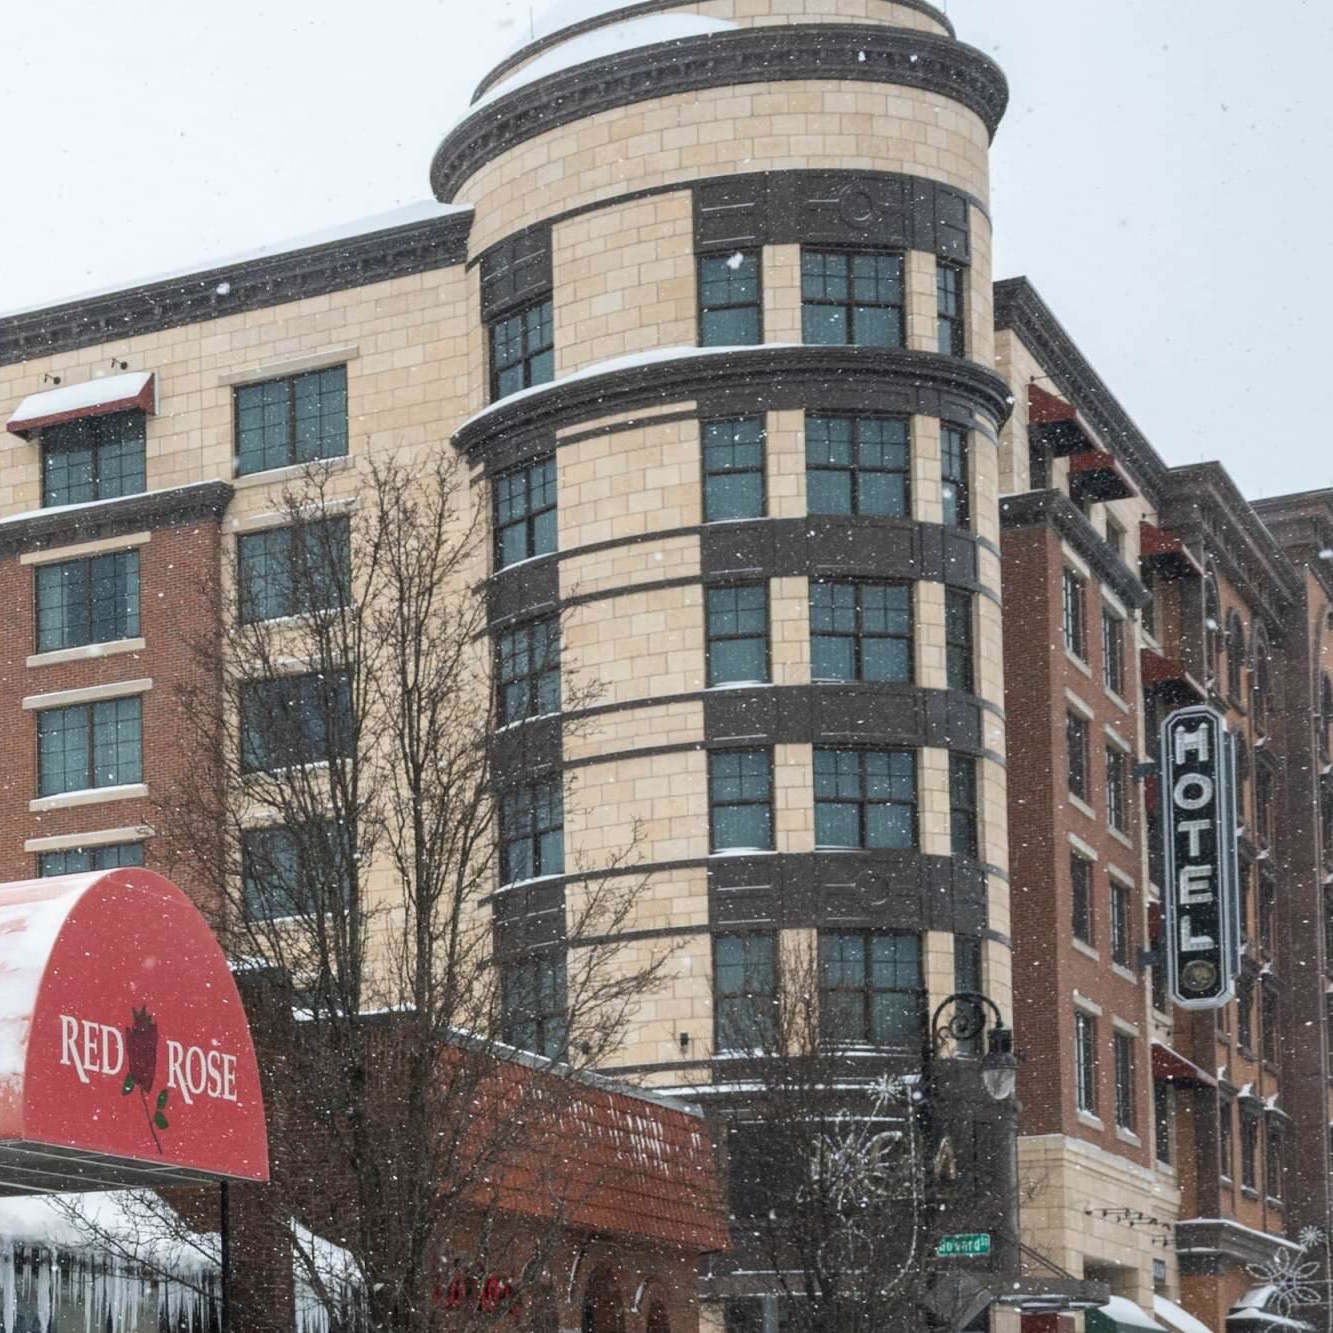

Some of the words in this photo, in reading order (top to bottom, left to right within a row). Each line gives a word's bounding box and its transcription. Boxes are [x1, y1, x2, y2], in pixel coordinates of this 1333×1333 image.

[1173, 722, 1216, 952] HOTEL
[59, 1014, 125, 1084] RED
[165, 1039, 239, 1106] ROSE
